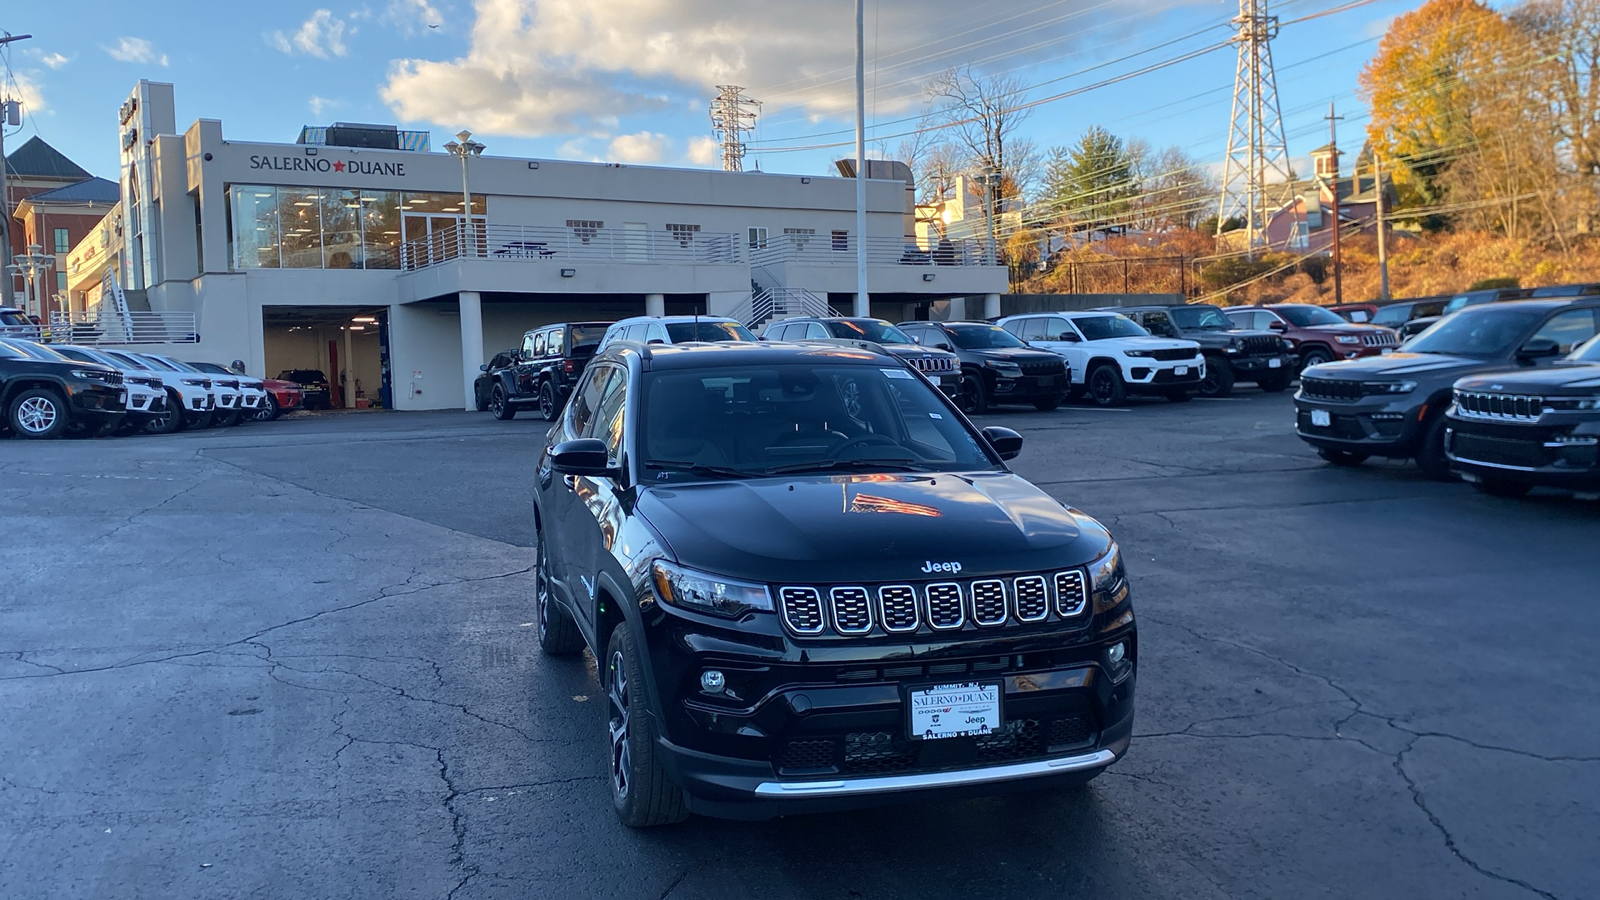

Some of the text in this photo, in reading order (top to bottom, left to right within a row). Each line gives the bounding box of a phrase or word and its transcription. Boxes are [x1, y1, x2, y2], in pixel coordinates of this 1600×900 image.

[250, 155, 406, 176] SALERNO DUANE
[921, 560, 962, 574] Jeep
[914, 692, 996, 706] SALERNO DUANE
[965, 716, 986, 724] Jeep
[922, 728, 993, 740] SALERNO DUANE
